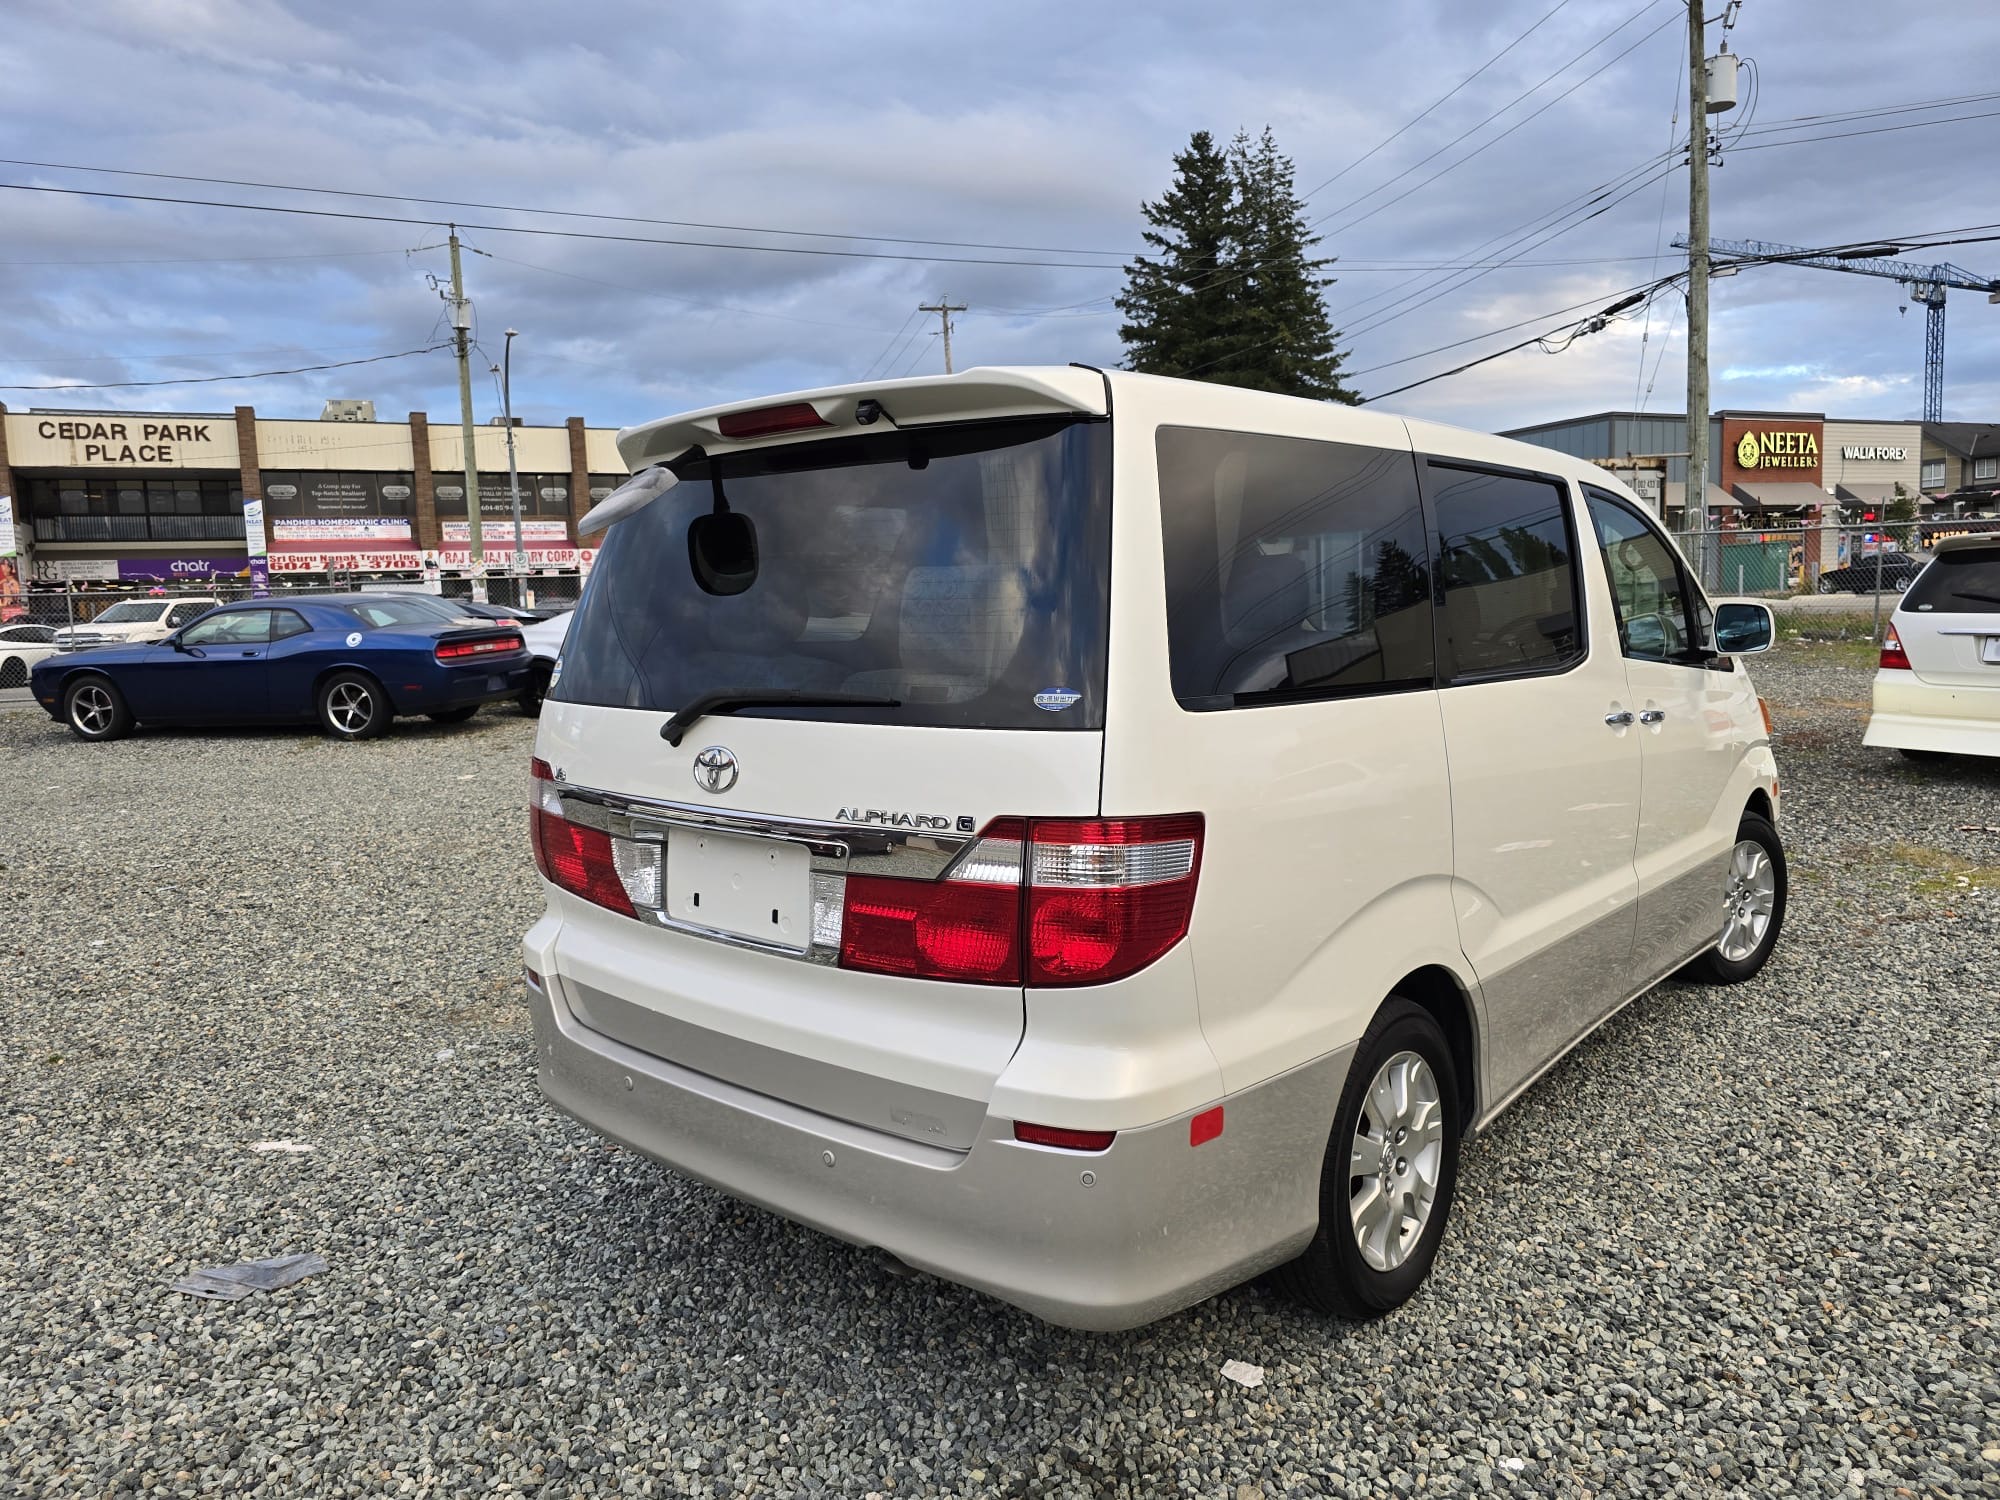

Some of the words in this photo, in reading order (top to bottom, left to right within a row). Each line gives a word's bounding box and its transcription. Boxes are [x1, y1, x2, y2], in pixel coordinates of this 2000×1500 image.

[38, 421, 127, 440] CEDAR
[143, 424, 211, 441] PARK
[1760, 431, 1818, 454] NEETA
[85, 444, 174, 462] PLACE
[1843, 446, 1876, 460] WALIA
[1877, 447, 1908, 461] FOREX
[1760, 456, 1818, 469] JEWELLERS
[275, 519, 316, 527] PANDHER
[317, 518, 378, 526] HOMEOPATHIC
[379, 518, 409, 526] CLINIC
[269, 555, 287, 563] Sri
[288, 555, 317, 563] Guru
[320, 554, 357, 562] Nanak
[359, 553, 397, 561] Travel
[445, 551, 465, 564] RAJ
[547, 550, 576, 562] CORP.
[170, 560, 210, 572] chatr
[836, 807, 952, 829] ALPHARD
